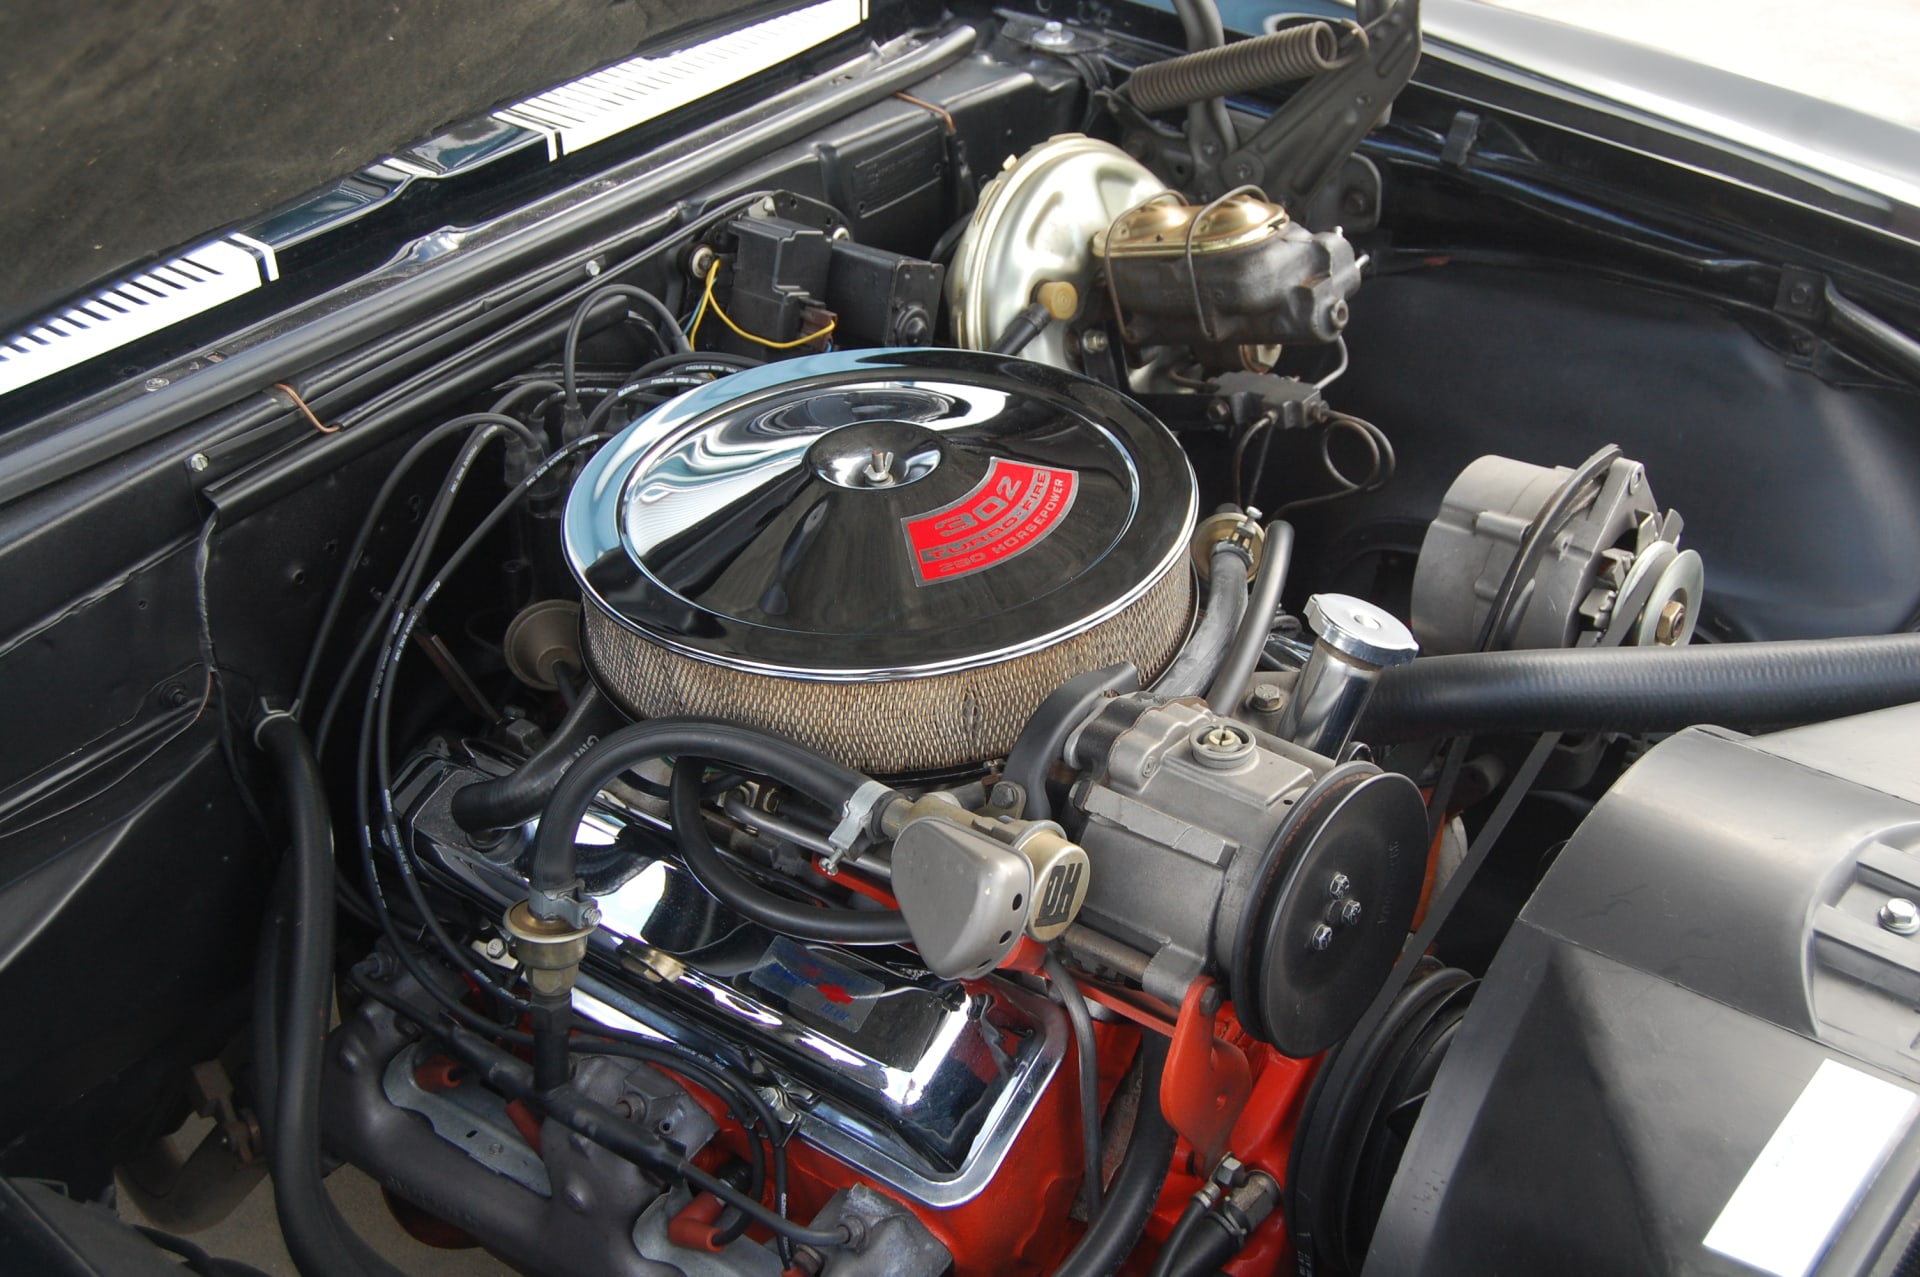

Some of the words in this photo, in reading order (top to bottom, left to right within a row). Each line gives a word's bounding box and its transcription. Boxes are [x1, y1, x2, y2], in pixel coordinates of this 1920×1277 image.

[927, 470, 1047, 559] TURBO-FIRE
[934, 475, 1022, 537] 302
[992, 478, 1064, 554] HORSEPOWER
